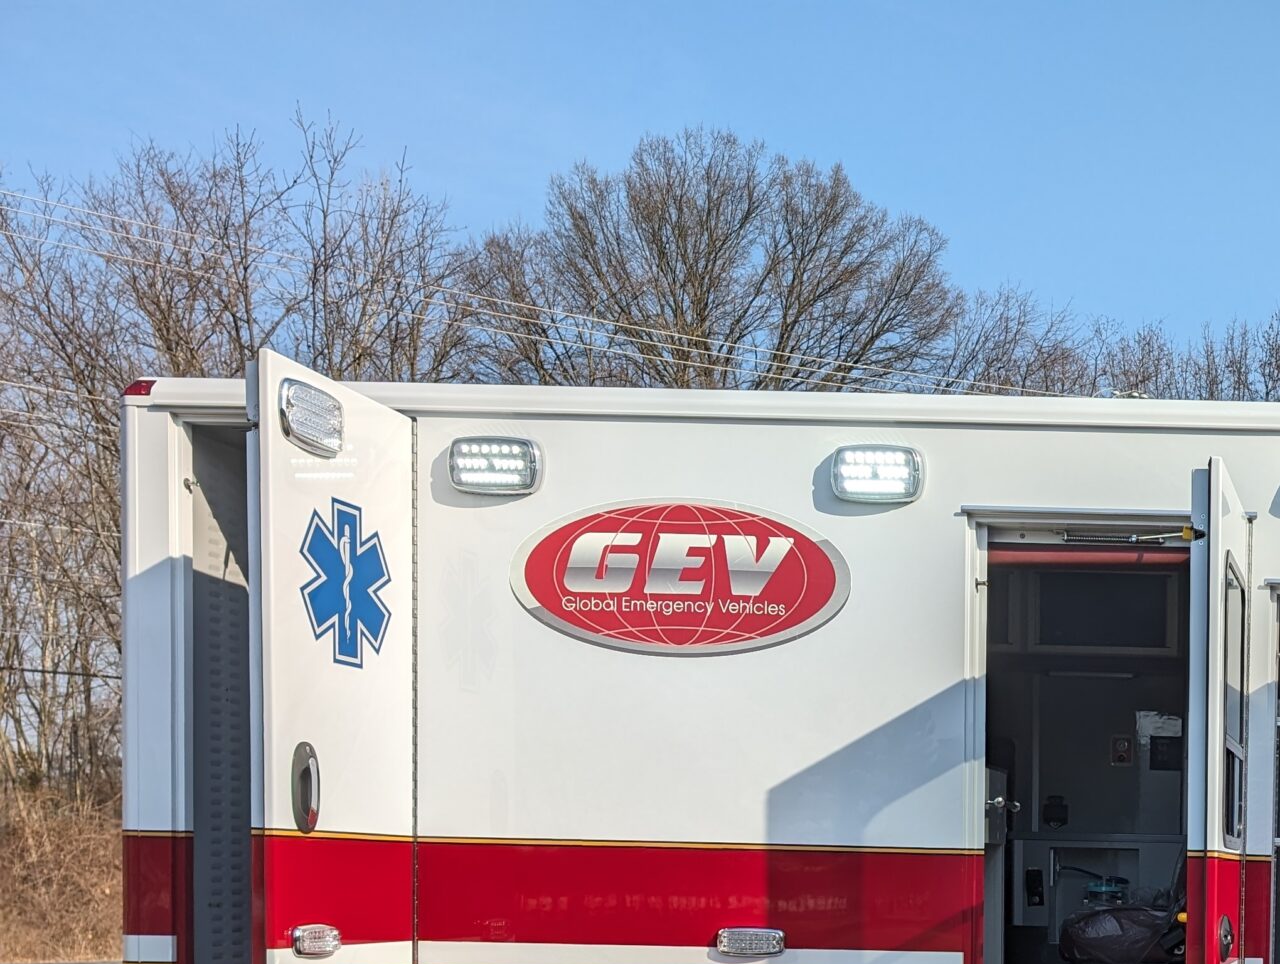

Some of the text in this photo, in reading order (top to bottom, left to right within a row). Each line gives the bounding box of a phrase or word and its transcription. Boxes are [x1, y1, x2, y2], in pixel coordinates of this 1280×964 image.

[563, 532, 795, 597] GEV
[562, 596, 786, 616] Global Emergency Vehicles
